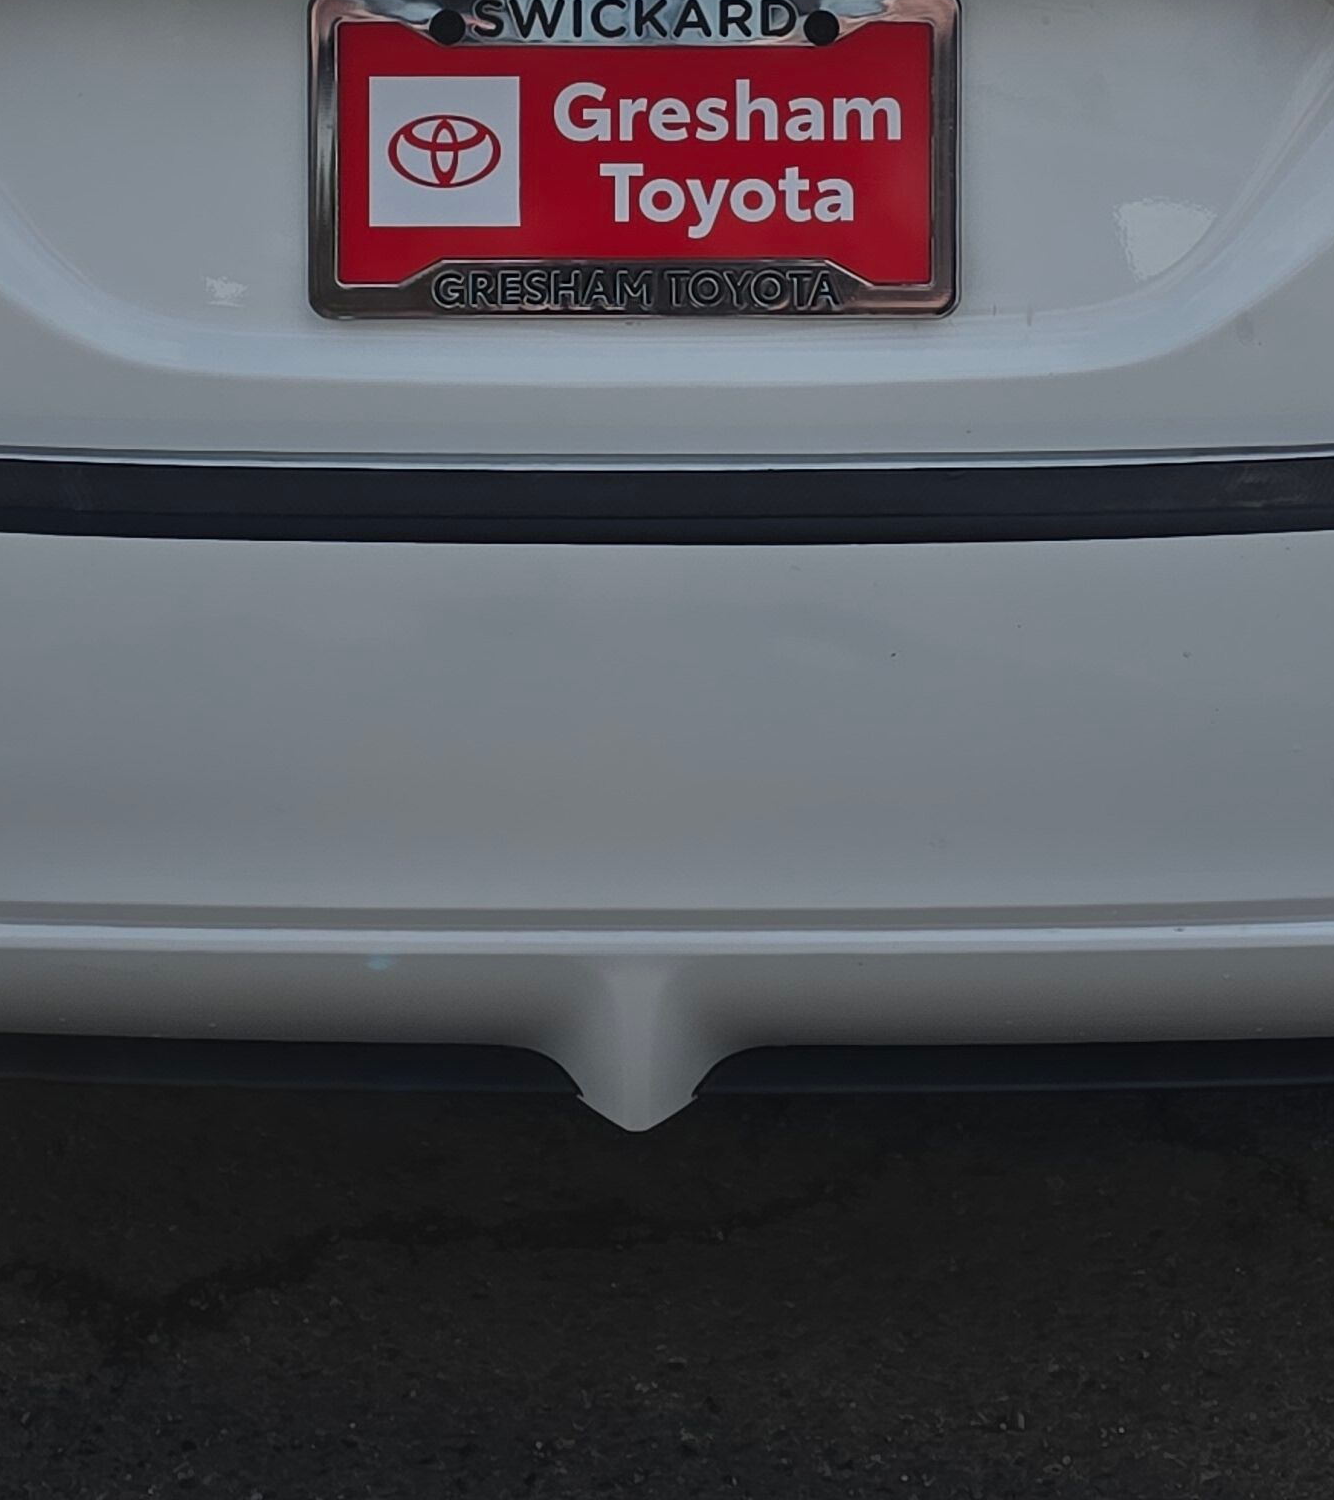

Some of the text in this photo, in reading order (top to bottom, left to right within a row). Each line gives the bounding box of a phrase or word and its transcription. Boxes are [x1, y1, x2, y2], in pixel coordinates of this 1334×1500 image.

[553, 79, 902, 142] Gresham
[599, 163, 855, 239] Toyota
[431, 270, 844, 312] GRESHAM TOYOTA
